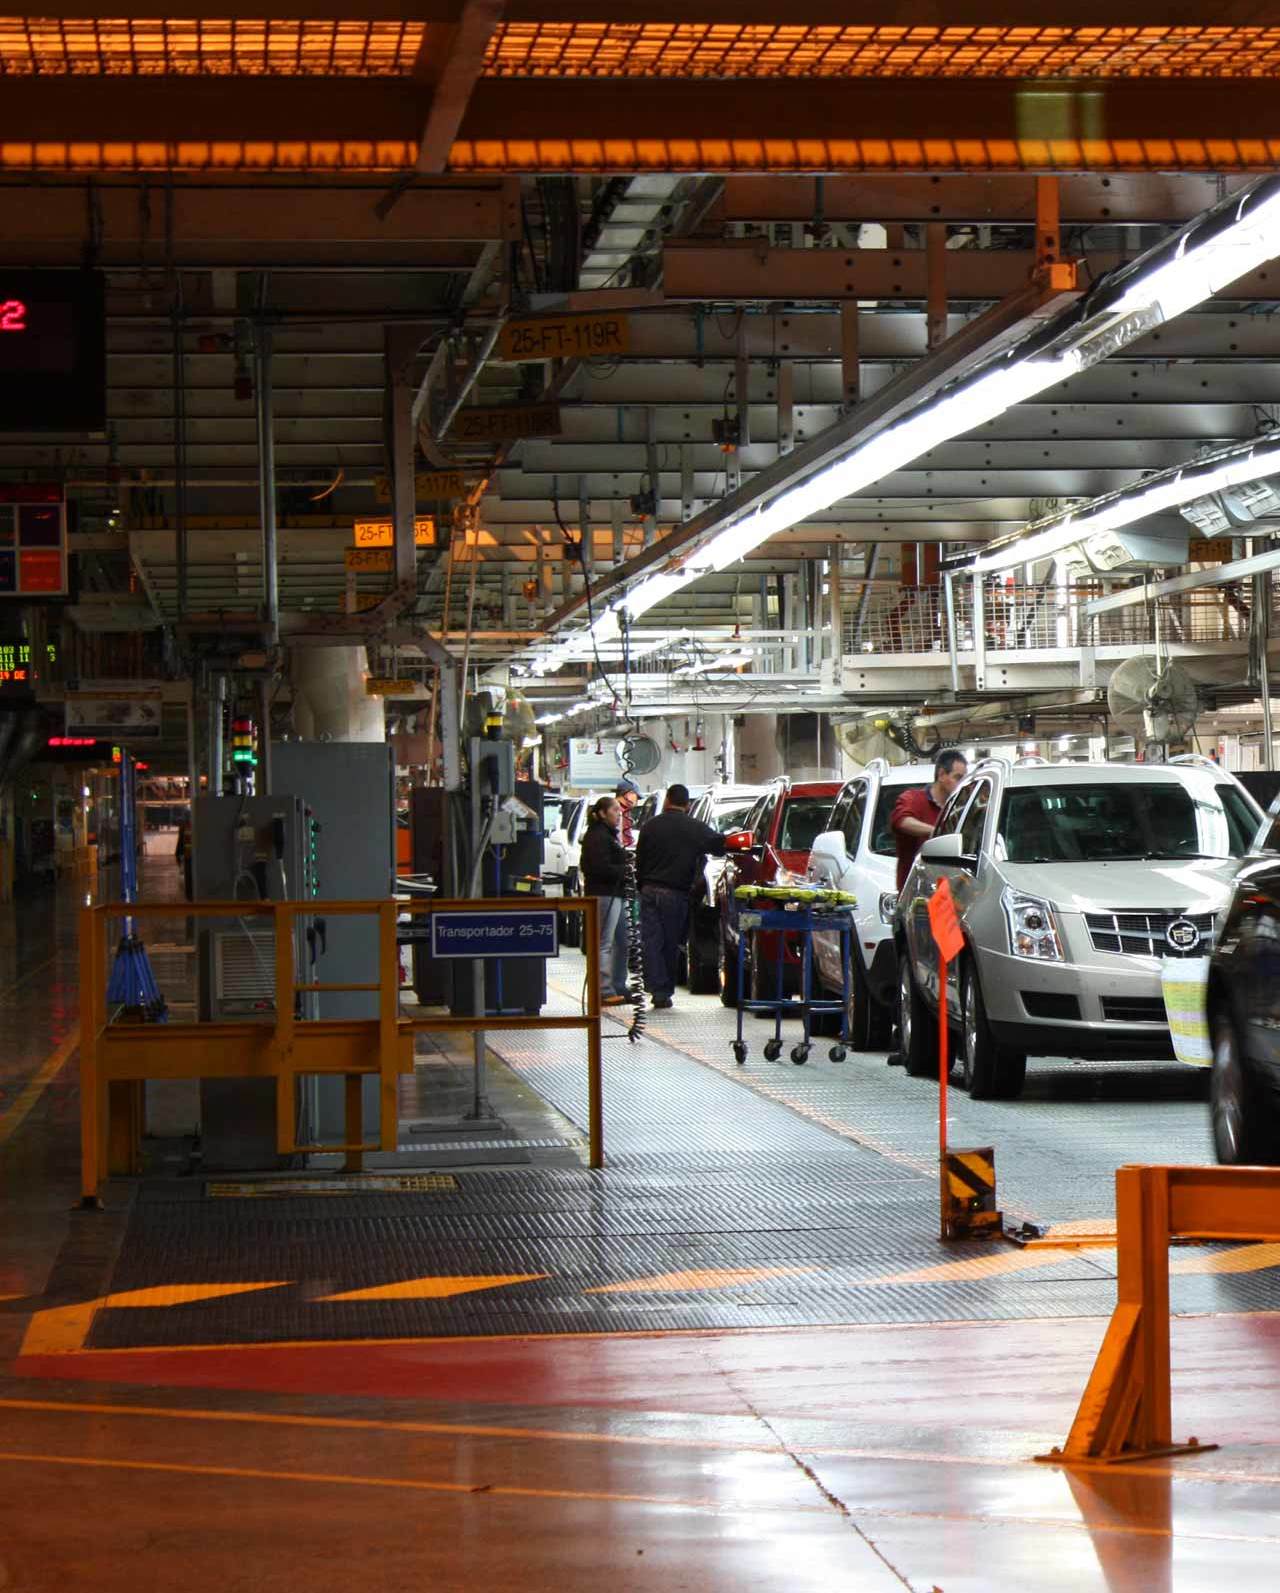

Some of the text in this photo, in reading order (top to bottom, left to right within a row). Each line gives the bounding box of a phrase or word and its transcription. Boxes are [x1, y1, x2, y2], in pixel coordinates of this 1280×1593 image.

[511, 320, 623, 354] 25-FT-119R
[437, 924, 554, 939] Transportador 25-75
